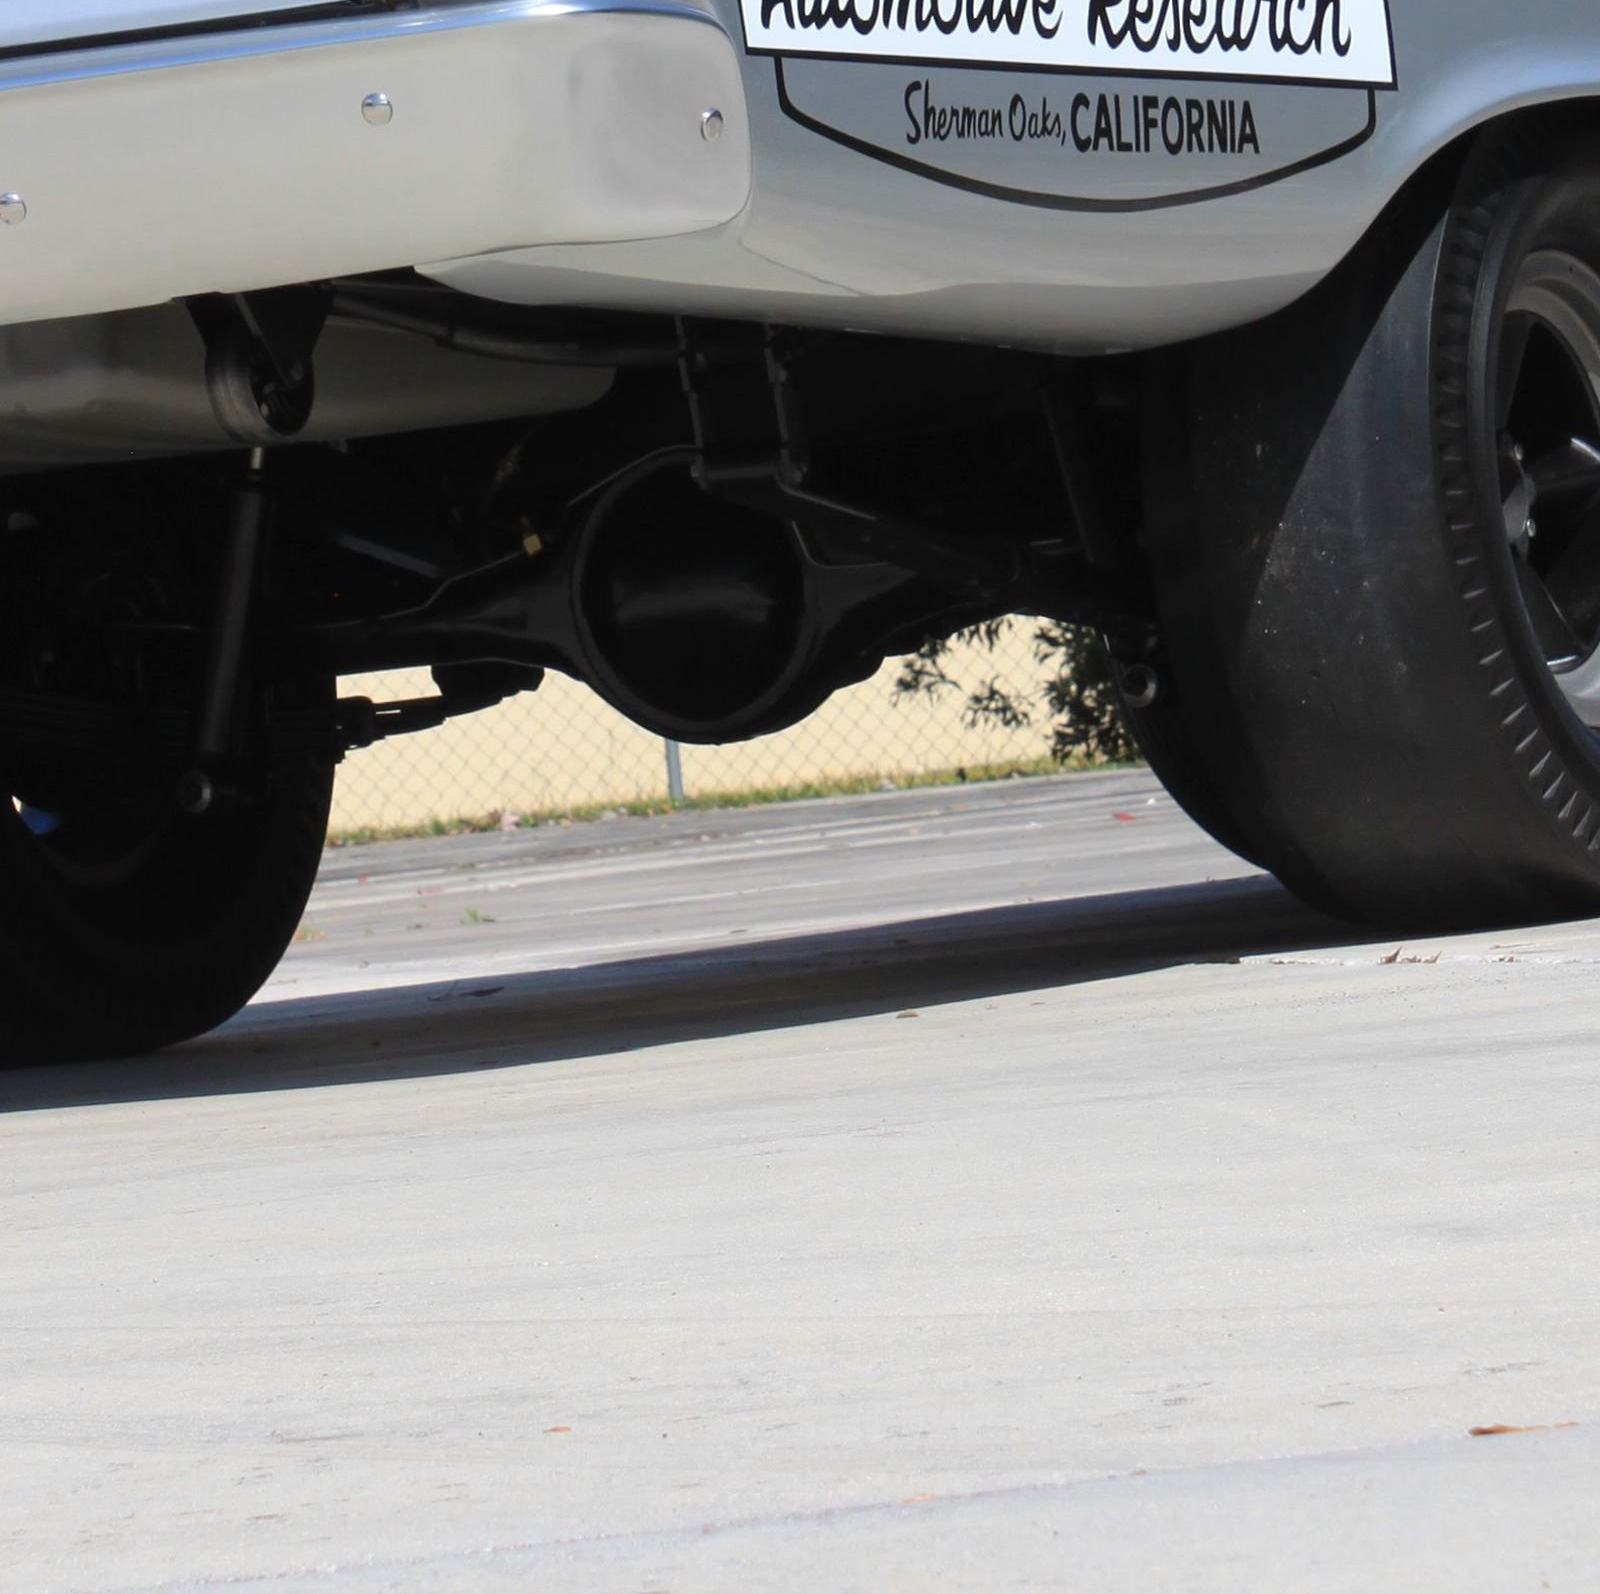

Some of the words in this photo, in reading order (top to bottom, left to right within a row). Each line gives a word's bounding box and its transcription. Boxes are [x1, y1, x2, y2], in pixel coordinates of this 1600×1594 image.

[903, 80, 1003, 145] Sherman
[1009, 100, 1066, 146] Oaks,
[1070, 92, 1261, 155] CALIFORNIA
